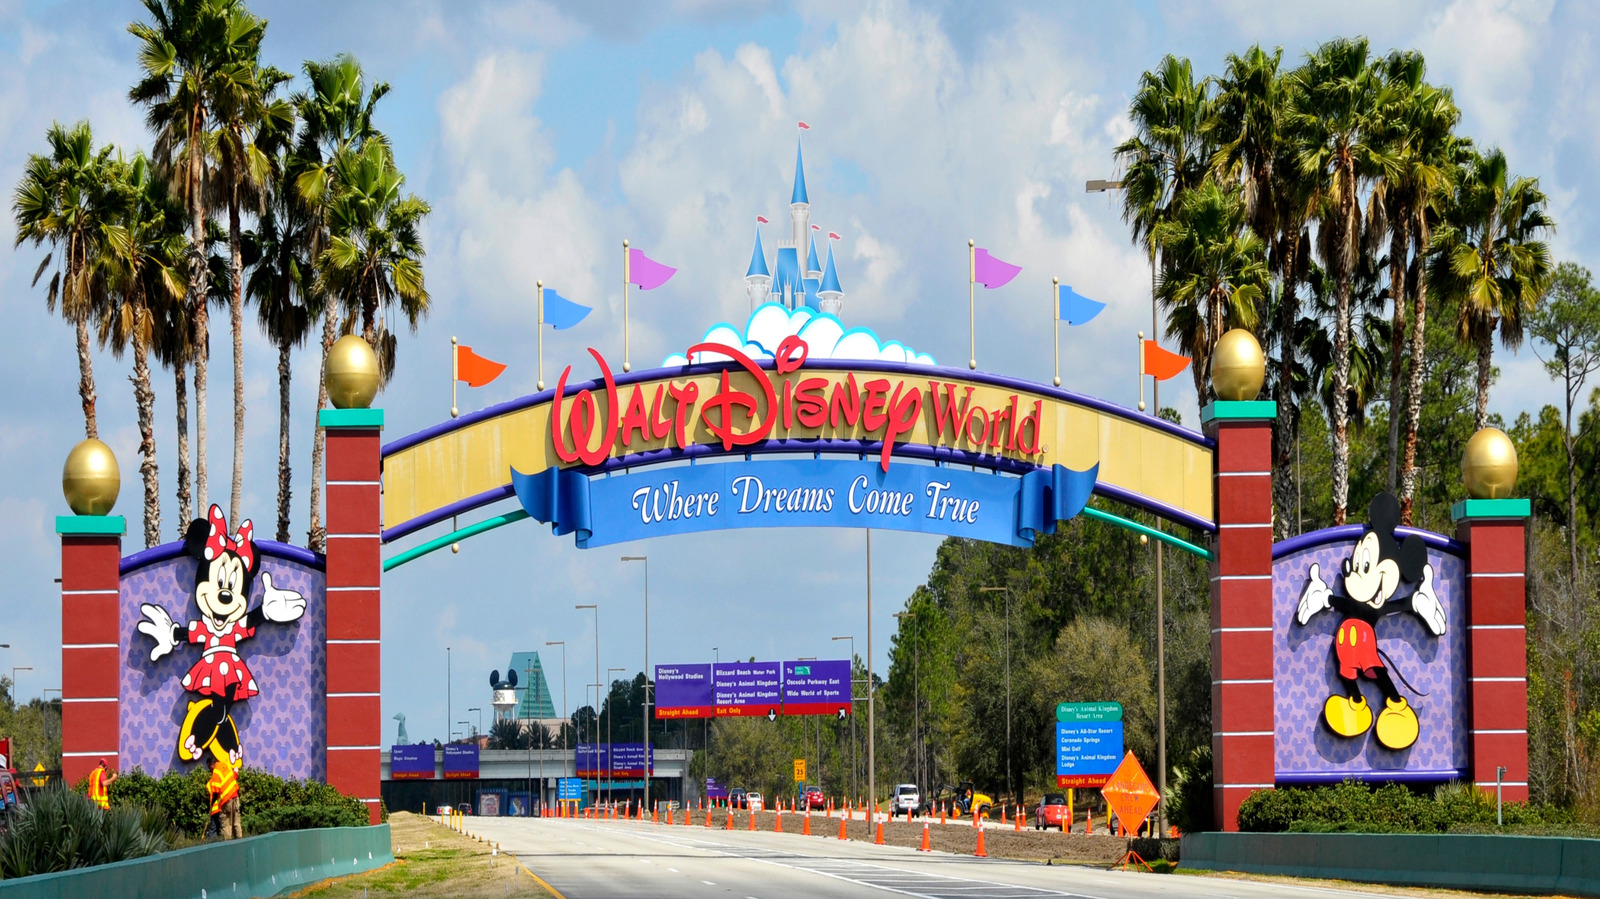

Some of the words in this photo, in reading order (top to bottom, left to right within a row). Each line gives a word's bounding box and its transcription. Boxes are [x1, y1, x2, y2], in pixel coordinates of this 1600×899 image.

[928, 380, 1042, 456] World
[632, 480, 720, 524] Where
[731, 475, 835, 515] Dreams
[847, 475, 915, 516] Come
[926, 481, 980, 523] True
[1120, 793, 1138, 802] CREW
[1120, 806, 1143, 815] AHEAD
